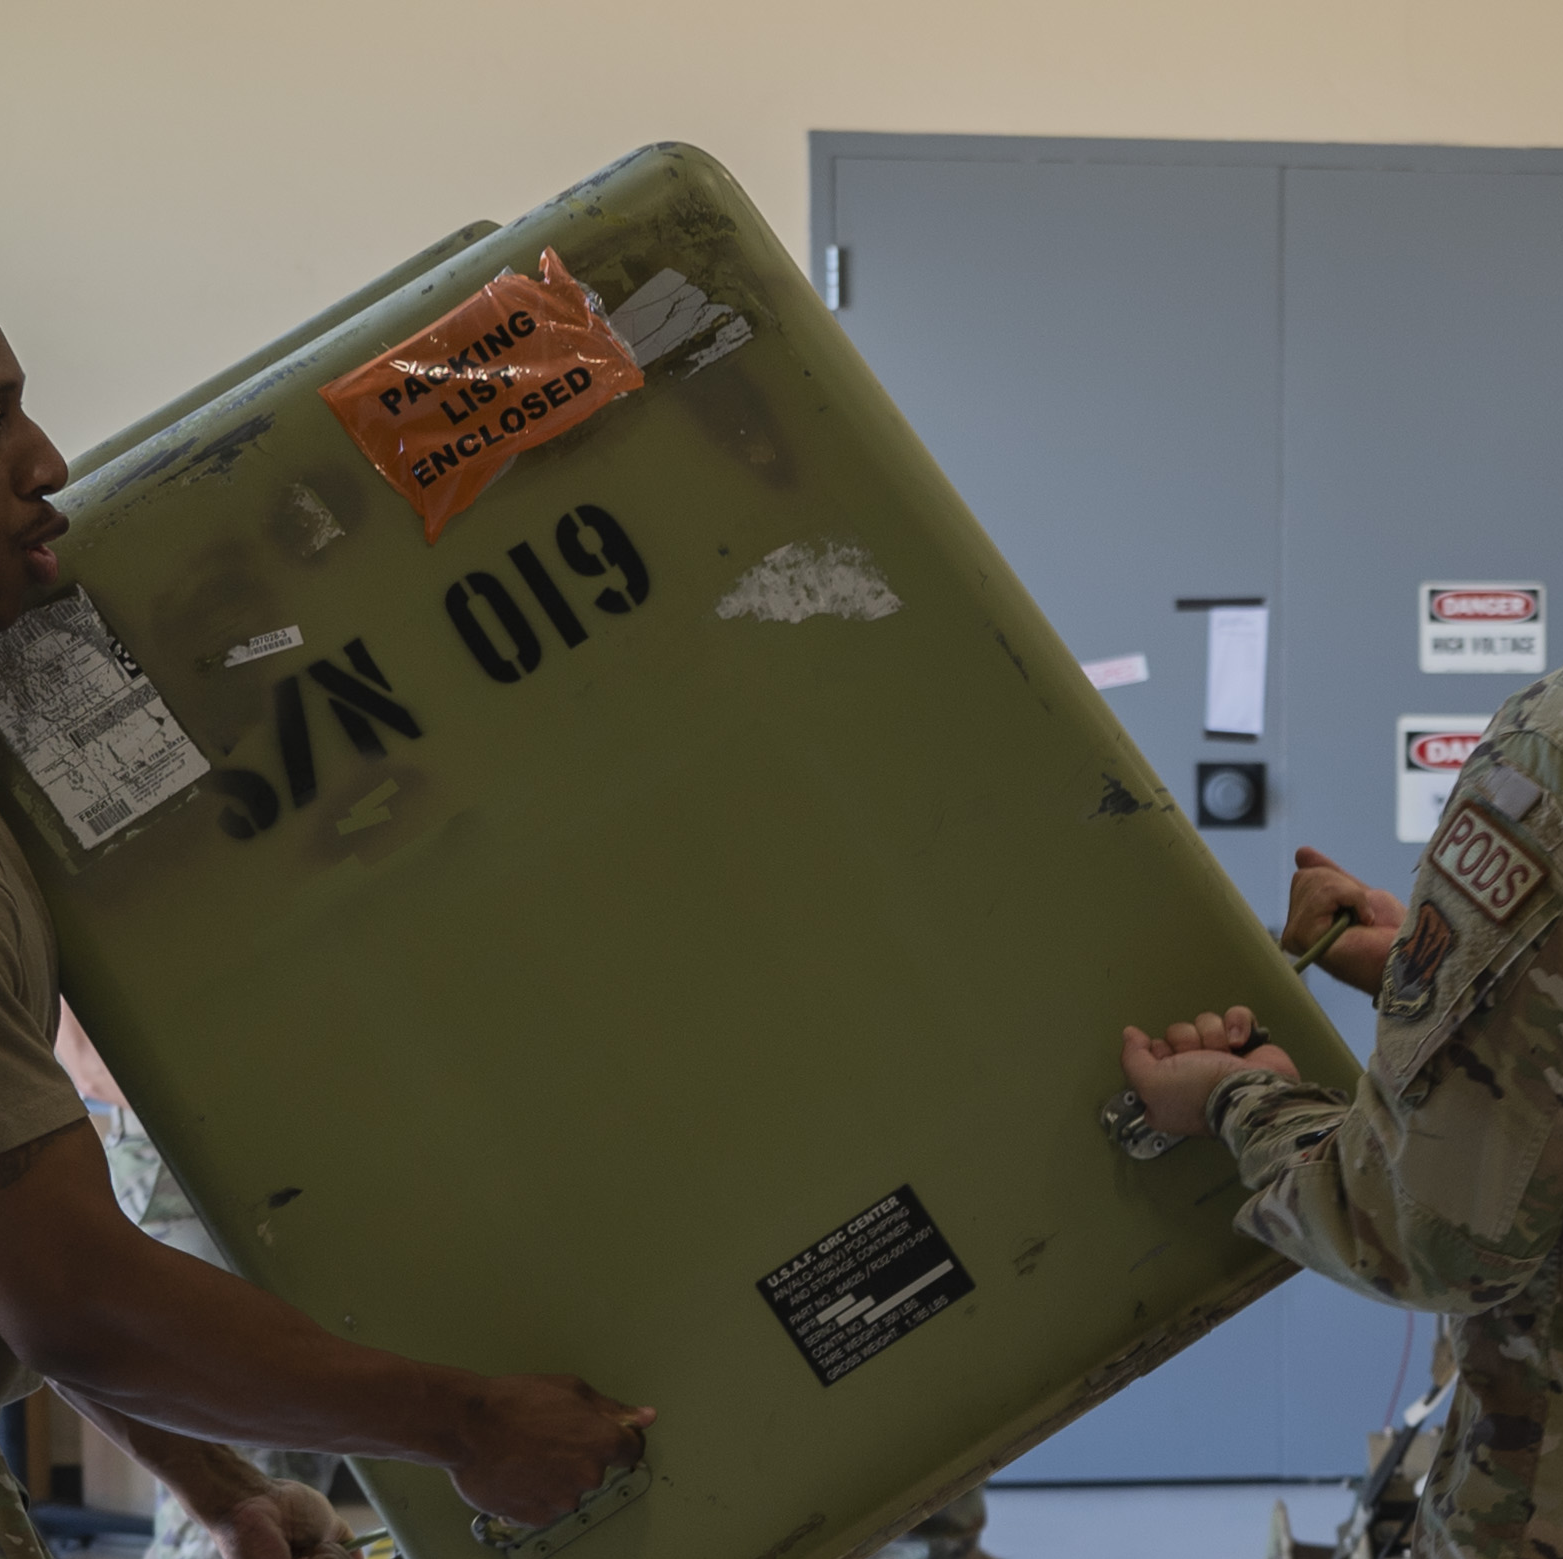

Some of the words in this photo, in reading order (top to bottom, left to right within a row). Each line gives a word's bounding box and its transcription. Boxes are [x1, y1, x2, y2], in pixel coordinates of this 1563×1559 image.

[378, 310, 537, 417] PACKING
[440, 368, 516, 426] LIST
[411, 365, 593, 489] ENCLOSED
[443, 503, 652, 684] 019
[1441, 596, 1525, 616] DANGER
[1439, 816, 1529, 906] PODS
[767, 1251, 816, 1287] U.S.A.F.
[817, 1231, 846, 1253] QRC
[846, 1196, 899, 1234] CENTER
[788, 1288, 810, 1305] AND
[810, 1257, 856, 1291] STORAGE
[855, 1221, 910, 1260] CONTAINER
[845, 1234, 868, 1252] POD
[867, 1206, 910, 1238] SHIPPING
[789, 1304, 814, 1324] PART
[819, 1348, 844, 1368] TARE
[826, 1353, 861, 1380] GROSS
